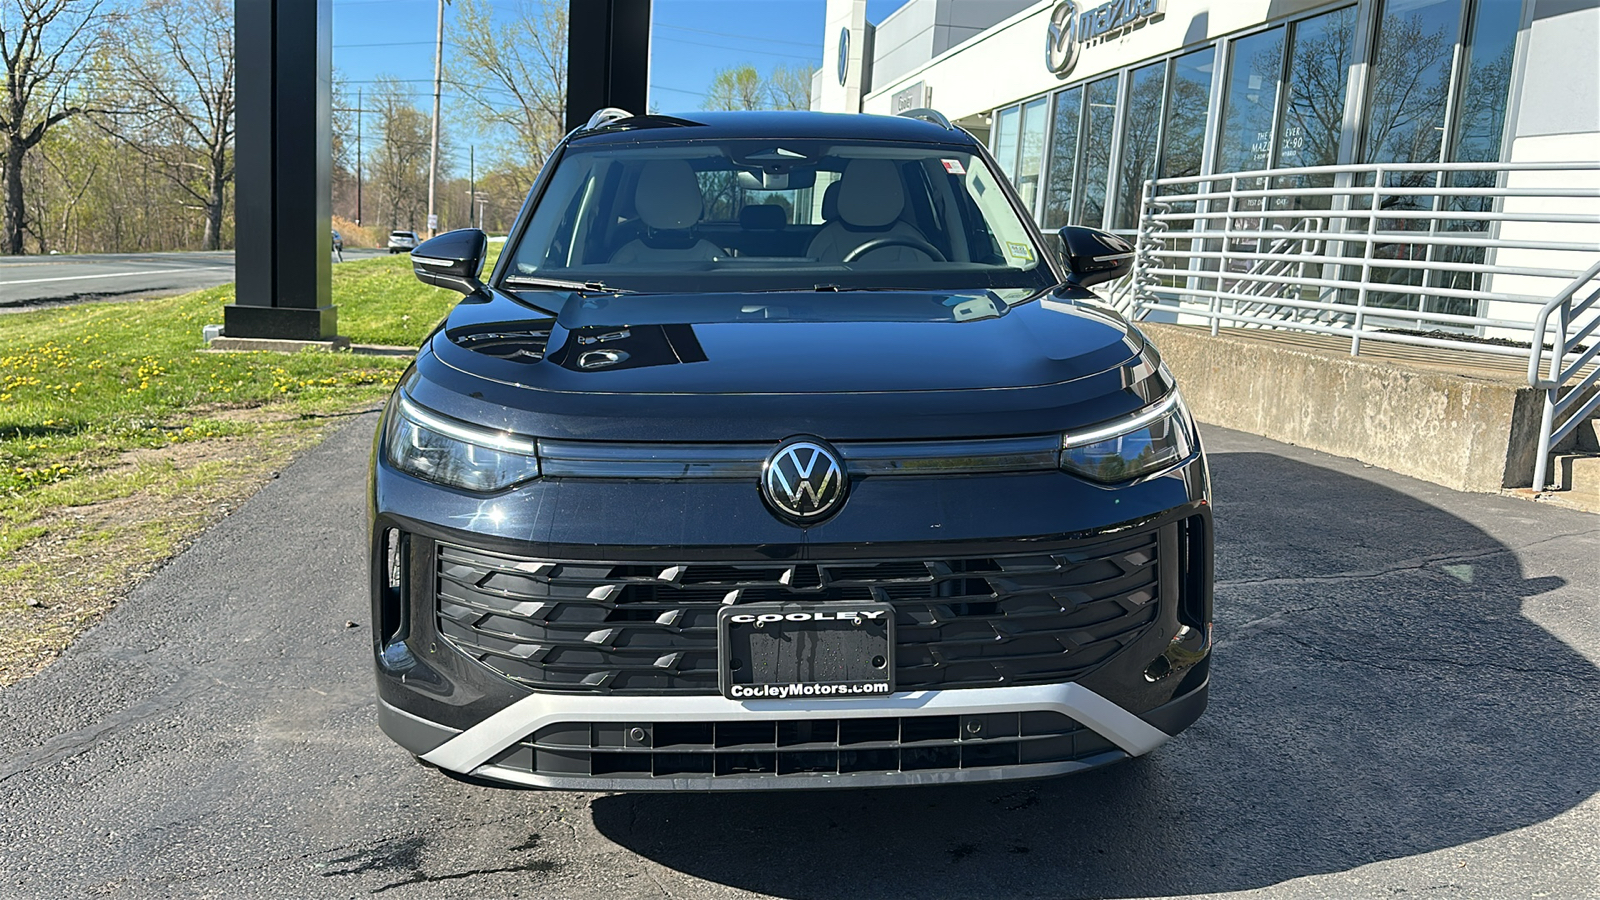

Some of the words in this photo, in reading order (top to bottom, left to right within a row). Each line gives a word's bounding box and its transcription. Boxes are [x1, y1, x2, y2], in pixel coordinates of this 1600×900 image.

[1257, 131, 1268, 141] THE
[731, 610, 885, 623] COOLEY
[731, 682, 889, 698] CooleyMotors.com
